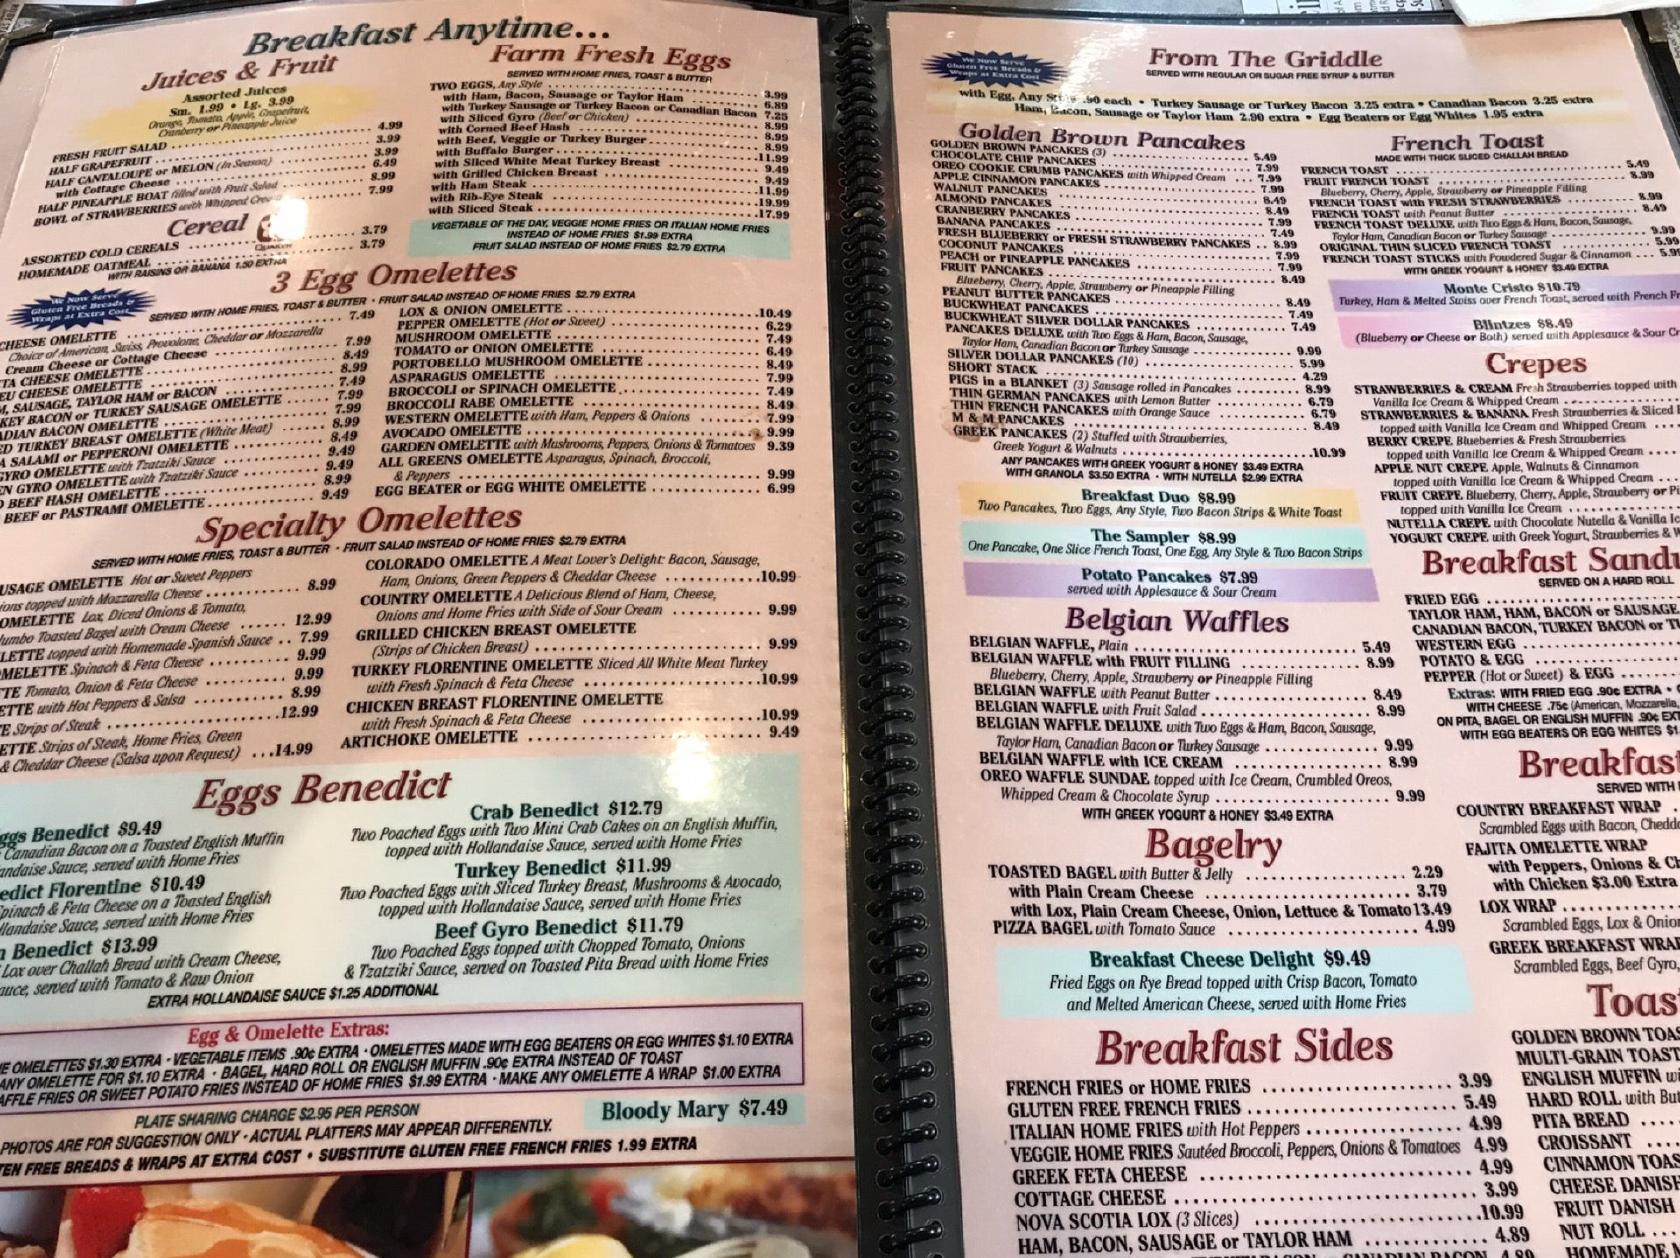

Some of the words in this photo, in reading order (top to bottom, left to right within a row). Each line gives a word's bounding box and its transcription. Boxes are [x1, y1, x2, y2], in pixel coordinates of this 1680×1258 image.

[242, 22, 418, 56] Breakfast
[489, 44, 565, 63] Farm
[574, 44, 654, 64] Fresh
[663, 47, 732, 73] Eggs
[1149, 48, 1218, 67] From
[1228, 50, 1276, 68] The
[1285, 50, 1382, 68] Griddle
[140, 69, 228, 92] Juices
[235, 61, 260, 81] &
[268, 53, 339, 77] Fruit
[506, 70, 544, 78] SERVED
[546, 70, 571, 78] WITH
[571, 70, 602, 78] HOME
[602, 70, 632, 80] FRIES,
[634, 72, 666, 80] TOAST
[666, 73, 673, 81] &
[675, 74, 712, 83] BUTTER
[182, 88, 242, 104] Assorted
[244, 86, 287, 96] Juices
[52, 150, 90, 163] FRESH
[92, 146, 128, 158] FRUIT
[129, 142, 168, 154] SALAD
[378, 121, 403, 130] 4.99
[958, 122, 1041, 143] Golden
[1050, 128, 1128, 147] Brown
[1137, 132, 1246, 151] Pancakes
[1391, 134, 1472, 151] French
[1480, 134, 1544, 150] Toast
[1300, 166, 1348, 175] FRENCH
[1349, 166, 1388, 175] TOAST
[1626, 159, 1650, 168] 5.49
[428, 205, 454, 215] with
[457, 204, 494, 214] Sliced
[498, 202, 533, 213] Steak
[167, 213, 249, 238] Cereal
[936, 216, 986, 227] BANANA
[989, 218, 1051, 230] PANCAKES
[1270, 228, 1295, 238] 7.49
[271, 271, 291, 294] 3
[298, 268, 359, 296] Egg
[367, 261, 518, 286] Omelettes
[1443, 283, 1488, 294] Monte
[1491, 282, 1534, 294] Cristo
[1537, 281, 1581, 292] $10.79
[1472, 319, 1531, 331] Blintzes
[1537, 318, 1573, 329] $8.49
[392, 357, 481, 370] PORTOBELLO
[485, 355, 566, 367] MUSHROOM
[570, 355, 643, 366] OMELETTE
[766, 359, 794, 370] 8.49
[948, 361, 992, 373] SHORT
[996, 364, 1038, 375] STACK
[1302, 372, 1328, 381] 4.29
[1485, 352, 1588, 379] Crepes
[1367, 436, 1408, 447] BERRY
[1411, 436, 1453, 446] CREPE
[1456, 436, 1514, 446] Blueberries
[1516, 435, 1526, 445] &
[1528, 434, 1557, 444] Fresh
[1559, 433, 1626, 444] Strawberries
[59, 503, 129, 520] PASTRAMI
[131, 497, 206, 514] OMELETTE
[321, 488, 350, 500] 9.49
[1081, 488, 1154, 502] Breakfast
[1158, 491, 1190, 503] Duo
[1198, 492, 1236, 505] $8.99
[195, 510, 346, 550] Specialty
[357, 504, 522, 534] Omelettes
[1090, 528, 1122, 542] The
[1125, 529, 1190, 546] Sampler
[1198, 532, 1236, 544] $8.99
[1422, 548, 1578, 575] Breakfast
[1081, 568, 1133, 582] Potato
[1137, 569, 1212, 584] Pancakes
[1219, 570, 1258, 584] $7.99
[1538, 577, 1581, 588] SERVED
[1583, 576, 1600, 587] ON
[1602, 576, 1611, 586] A
[1612, 576, 1643, 586] HARD
[1645, 575, 1675, 585] ROLL
[1404, 594, 1446, 605] FRIED
[1450, 593, 1480, 605] EGG
[1064, 606, 1173, 637] Belgian
[1183, 609, 1289, 633] Waffles
[969, 635, 1031, 648] BELGIAN
[1034, 637, 1095, 653] WAFFLE,
[1098, 639, 1128, 652] Plain
[1362, 641, 1391, 654] 5.49
[340, 732, 430, 749] ARTICHOKE
[434, 730, 518, 745] OMELETTE
[769, 725, 800, 738] 9.49
[980, 768, 1022, 782] OREO
[1025, 770, 1085, 784] WAFFLE
[1088, 771, 1150, 785] SUNDAE
[192, 778, 282, 817] Eggs
[290, 769, 453, 805] Benedict
[470, 804, 514, 821] Crab
[519, 801, 599, 819] Benedict
[608, 800, 663, 816] $12.79
[1082, 807, 1111, 820] WITH
[1114, 808, 1154, 820] GREEK
[1158, 808, 1206, 821] YOGURT
[1208, 809, 1217, 822] &
[1219, 809, 1260, 822] HONEY
[1264, 809, 1294, 822] $3.49
[1296, 809, 1334, 822] EXTRA
[1456, 803, 1524, 818] COUNTRY
[1529, 800, 1615, 816] BREAKFAST
[1618, 800, 1662, 814] WRAP
[31, 823, 110, 843] Benedict
[117, 820, 162, 837] $9.49
[1144, 828, 1282, 868] Bagelry
[454, 862, 520, 884] Turkey
[526, 858, 606, 877] Benedict
[616, 857, 672, 875] $11.99
[47, 878, 142, 899] Florentine
[150, 874, 206, 893] $10.49
[434, 921, 478, 940] Beef
[482, 920, 529, 942] Gyro
[535, 918, 618, 936] Benedict
[627, 916, 684, 934] $11.79
[1089, 950, 1176, 968] Breakfast
[1180, 950, 1244, 968] Cheese
[1249, 950, 1315, 972] Delight
[1323, 949, 1371, 968] $9.49
[187, 1027, 221, 1048] Egg
[224, 1025, 240, 1043] &
[245, 1023, 325, 1042] Omelette
[330, 1021, 390, 1038] Extras:
[1095, 1028, 1282, 1065] Breakfast
[1294, 1027, 1393, 1063] Sides
[1006, 1080, 1072, 1096] FRENCH
[1076, 1079, 1124, 1096] FRIES
[1128, 1084, 1146, 1095] or
[1150, 1078, 1201, 1095] HOME
[1205, 1078, 1251, 1094] FRIES
[1458, 1072, 1492, 1088] 3.99
[134, 1114, 177, 1129] PLATE
[178, 1110, 238, 1127] SHARING
[240, 1107, 298, 1123] CHARGE
[298, 1106, 333, 1122] $2.95
[334, 1105, 362, 1119] PER
[364, 1103, 420, 1118] PERSON
[602, 1100, 672, 1124] Bloody
[678, 1100, 730, 1122] Mary
[739, 1098, 788, 1118] $7.49
[1538, 1133, 1632, 1150] CROISSANT
[1014, 1190, 1094, 1208] COTTAGE
[1098, 1188, 1166, 1206] CHEESE
[1484, 1180, 1518, 1198] 3.99
